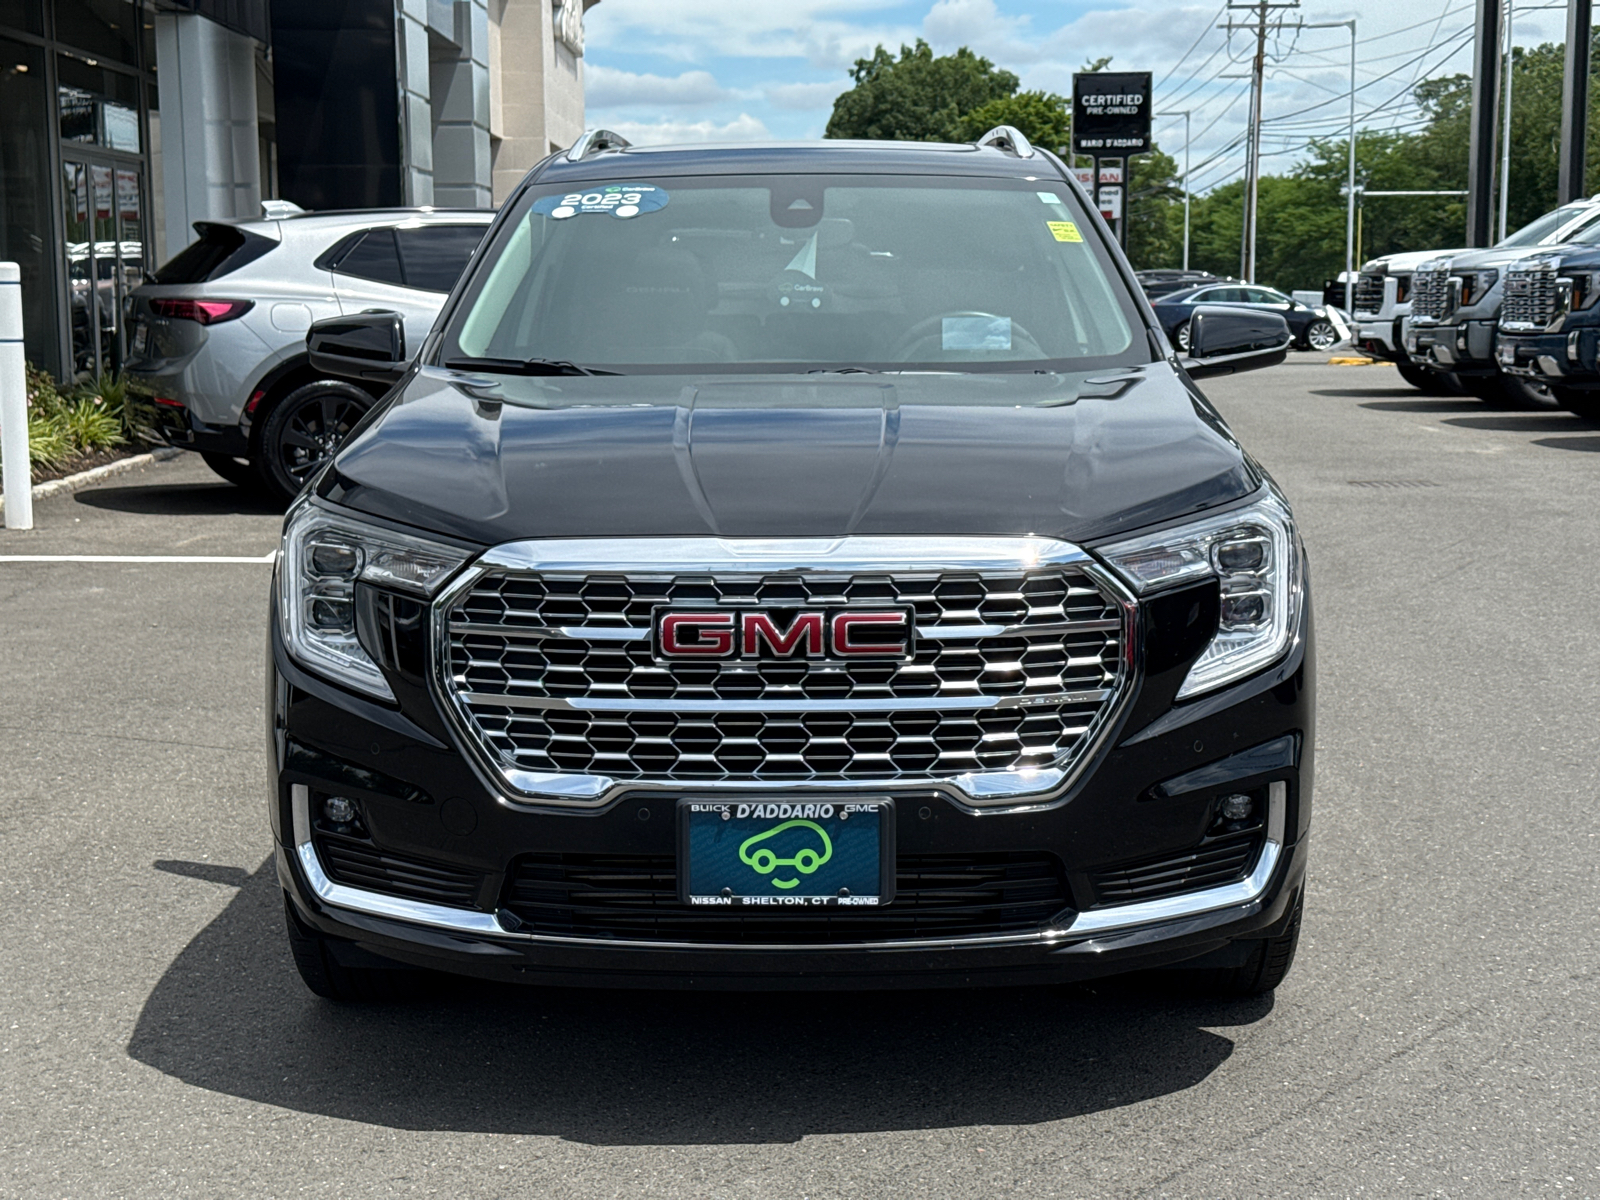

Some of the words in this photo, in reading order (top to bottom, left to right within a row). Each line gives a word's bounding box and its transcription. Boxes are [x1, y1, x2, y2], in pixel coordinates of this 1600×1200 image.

[1081, 94, 1143, 106] CERTIFIED
[1086, 106, 1138, 115] PRE-OWNED
[1080, 139, 1103, 147] MARIO
[560, 193, 642, 206] 2023
[660, 612, 907, 658] GMC
[691, 804, 731, 812] BUICK
[736, 803, 834, 819] D'ADDARIO
[844, 804, 879, 812] GMC
[691, 897, 732, 905] NISSAN
[742, 897, 808, 907] SHELTON,
[812, 897, 830, 905] CT
[838, 897, 879, 905] PRE-OWNED
